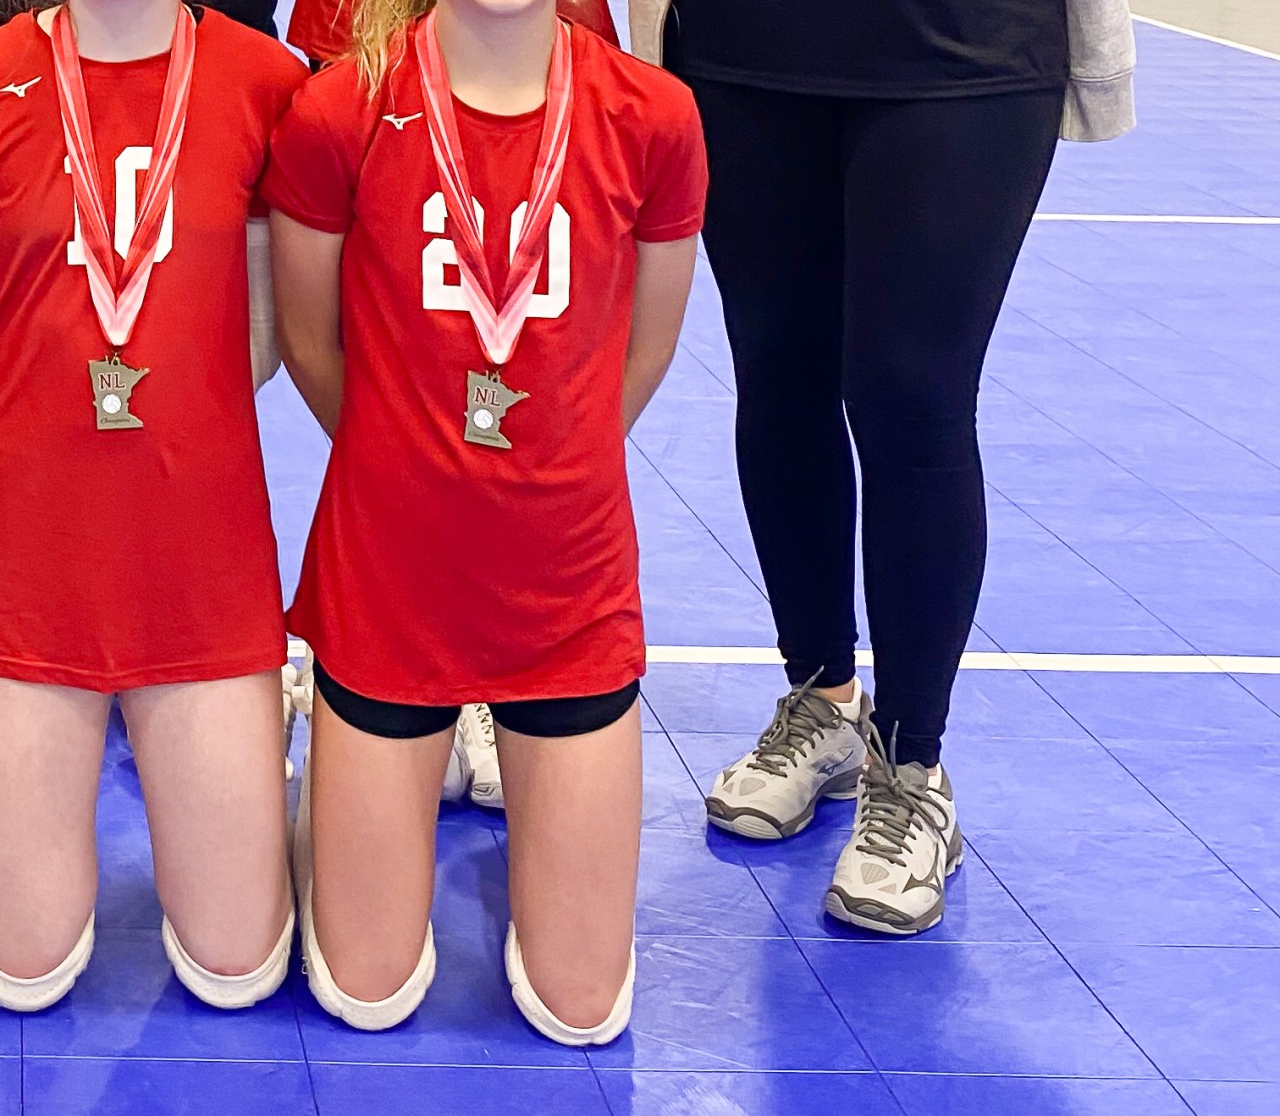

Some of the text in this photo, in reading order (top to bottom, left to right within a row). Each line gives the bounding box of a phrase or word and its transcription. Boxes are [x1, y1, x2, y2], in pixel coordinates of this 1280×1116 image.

[63, 146, 175, 266] 0
[422, 191, 571, 319] 20
[98, 372, 126, 390] NL
[473, 386, 502, 407] NL
